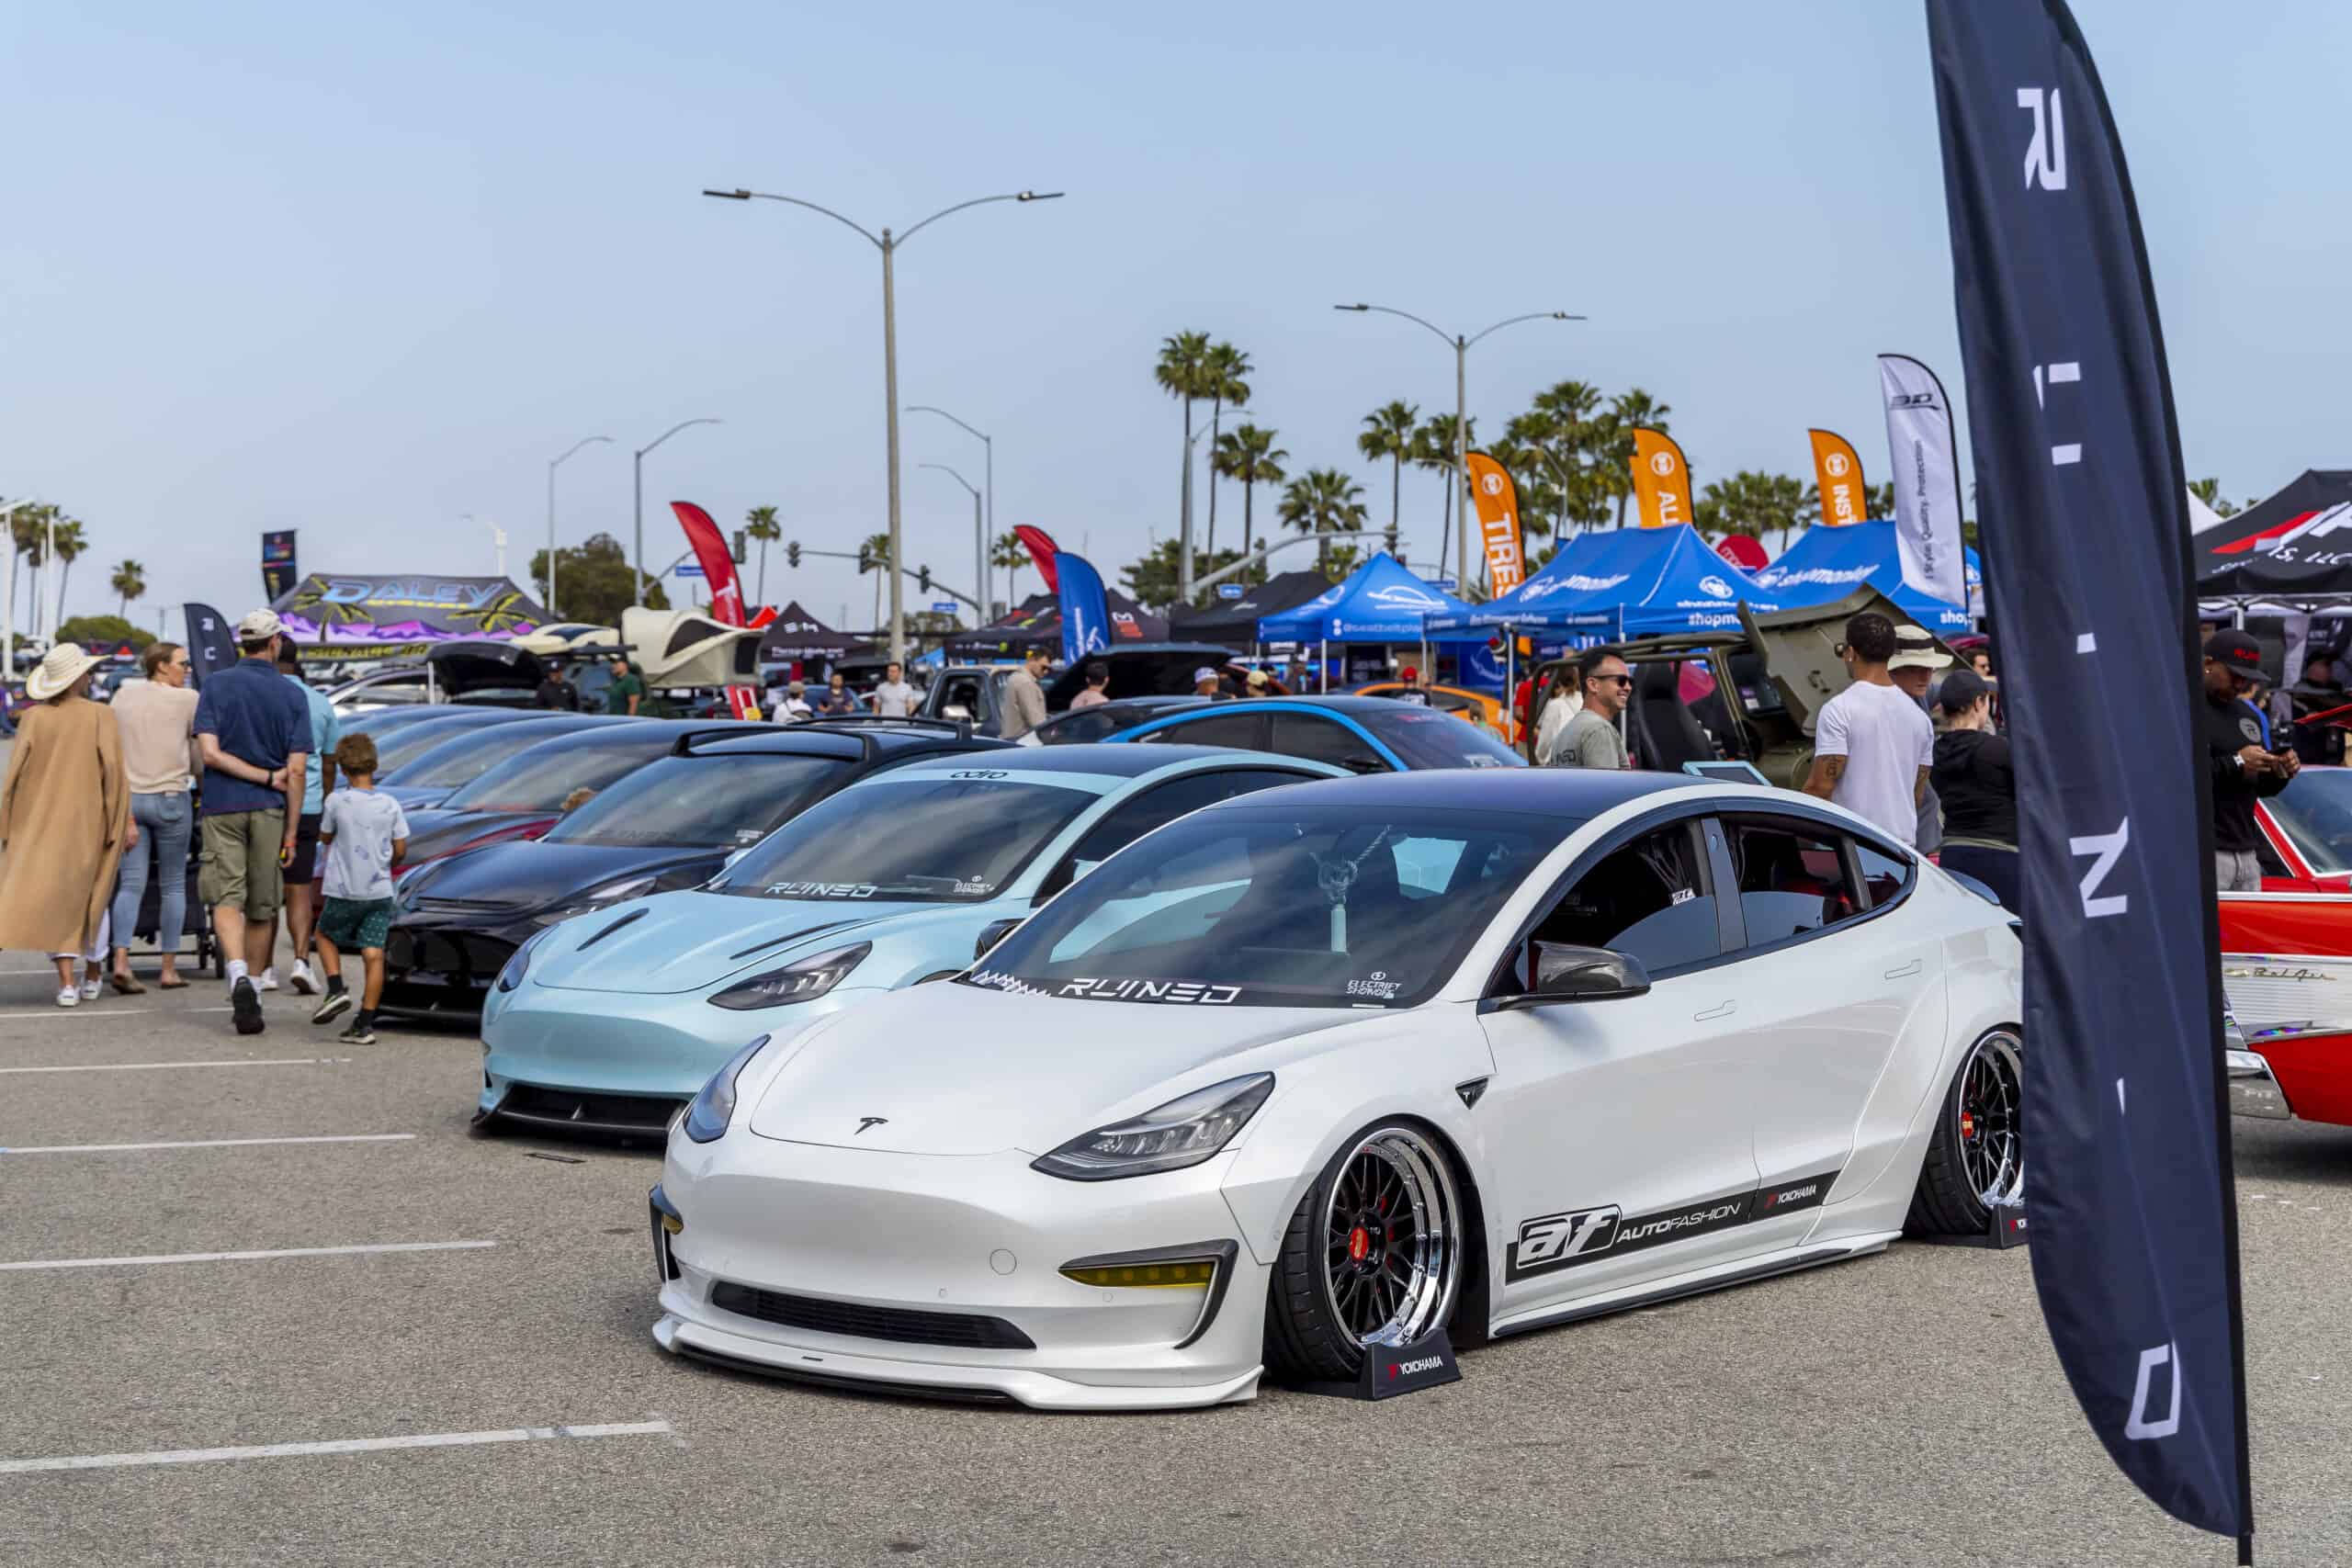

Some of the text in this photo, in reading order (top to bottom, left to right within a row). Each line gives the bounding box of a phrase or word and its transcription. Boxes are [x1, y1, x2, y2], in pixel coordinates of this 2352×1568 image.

[1058, 977, 1242, 1003] RUINED
[1617, 1202, 1741, 1243] AUTOFASHION
[1778, 1184, 1817, 1204] YOKOHAMA
[1399, 1355, 1443, 1375] YOKOHAMA
